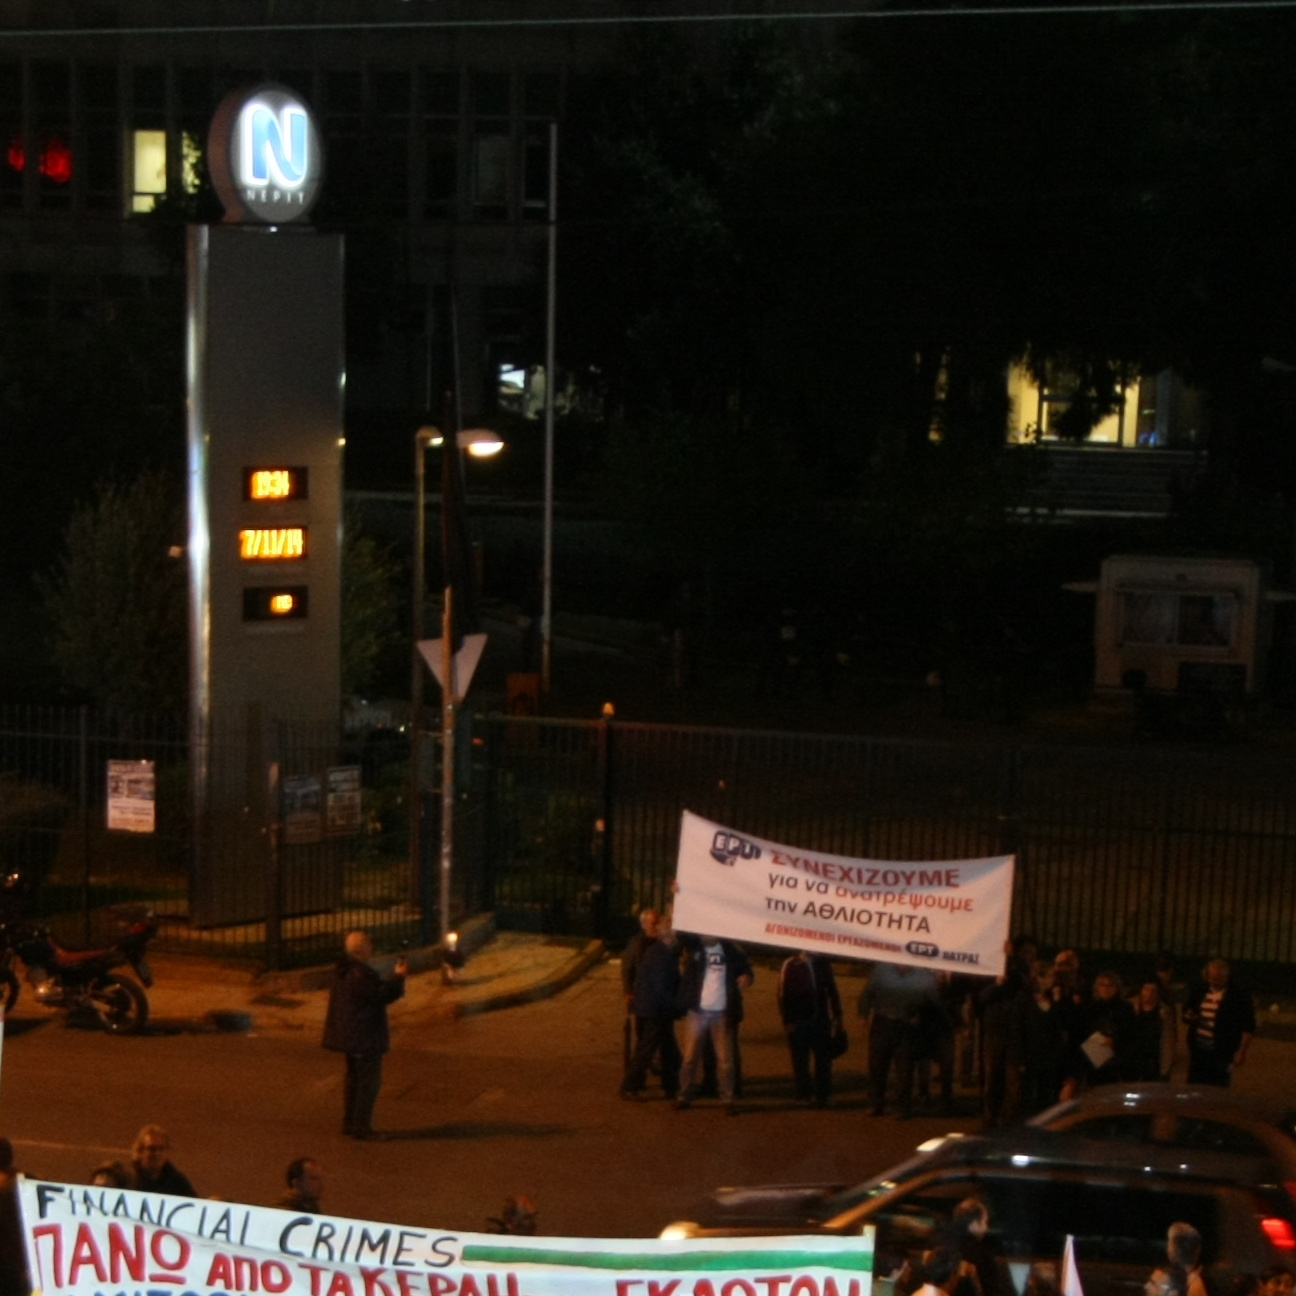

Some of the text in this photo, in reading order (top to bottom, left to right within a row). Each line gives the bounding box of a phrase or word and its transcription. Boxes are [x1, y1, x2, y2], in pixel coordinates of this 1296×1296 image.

[767, 871, 799, 891] για
[805, 878, 830, 895] να
[771, 850, 961, 888] ΣΥΝΕΧΙΖΟΥΜΕ
[802, 903, 932, 934] ΑΘΛΙΟΤΗΤΑ
[33, 1221, 192, 1288] ΠΑΝΩ
[205, 1252, 294, 1294] ΑΠΟ
[278, 1215, 462, 1270] CRIMES
